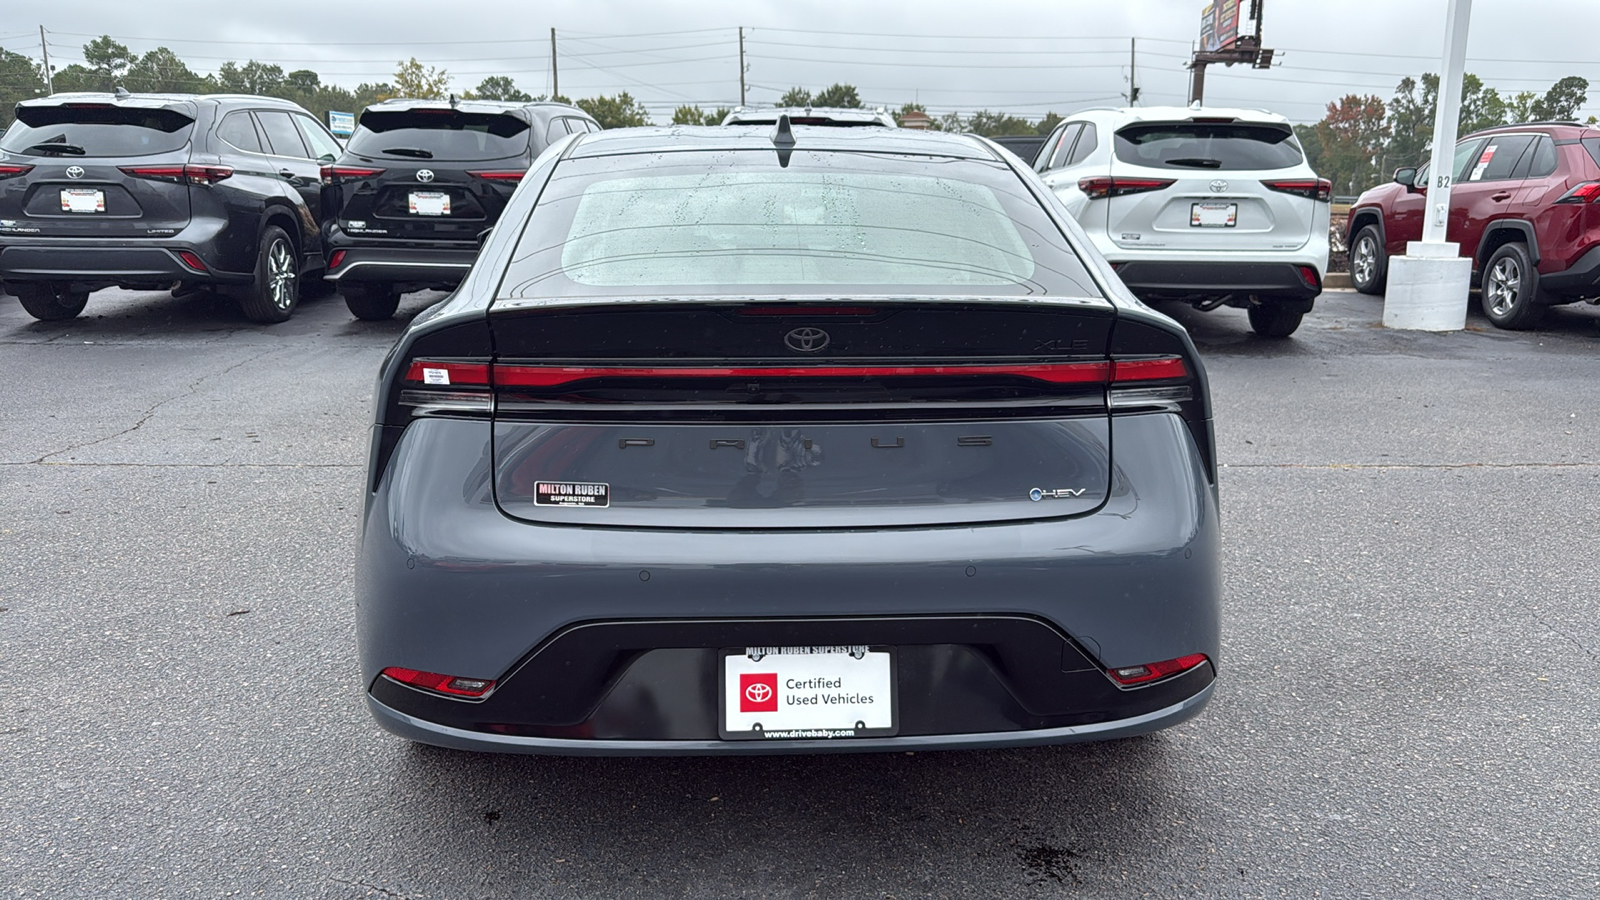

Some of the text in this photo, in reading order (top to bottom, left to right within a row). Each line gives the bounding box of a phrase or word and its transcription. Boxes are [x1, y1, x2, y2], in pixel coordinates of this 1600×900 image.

[1437, 175, 1450, 188] B2
[1033, 339, 1089, 351] XLE
[617, 434, 993, 449] PRIUS
[539, 484, 606, 496] MILTON RUBEN
[550, 495, 596, 503] SUPERSTORE
[745, 646, 779, 656] MILTON
[780, 646, 811, 655] RUBEN
[786, 677, 842, 690] Certified
[786, 692, 874, 706] Used Vehicles
[764, 729, 855, 739] www.drivebaby.com
